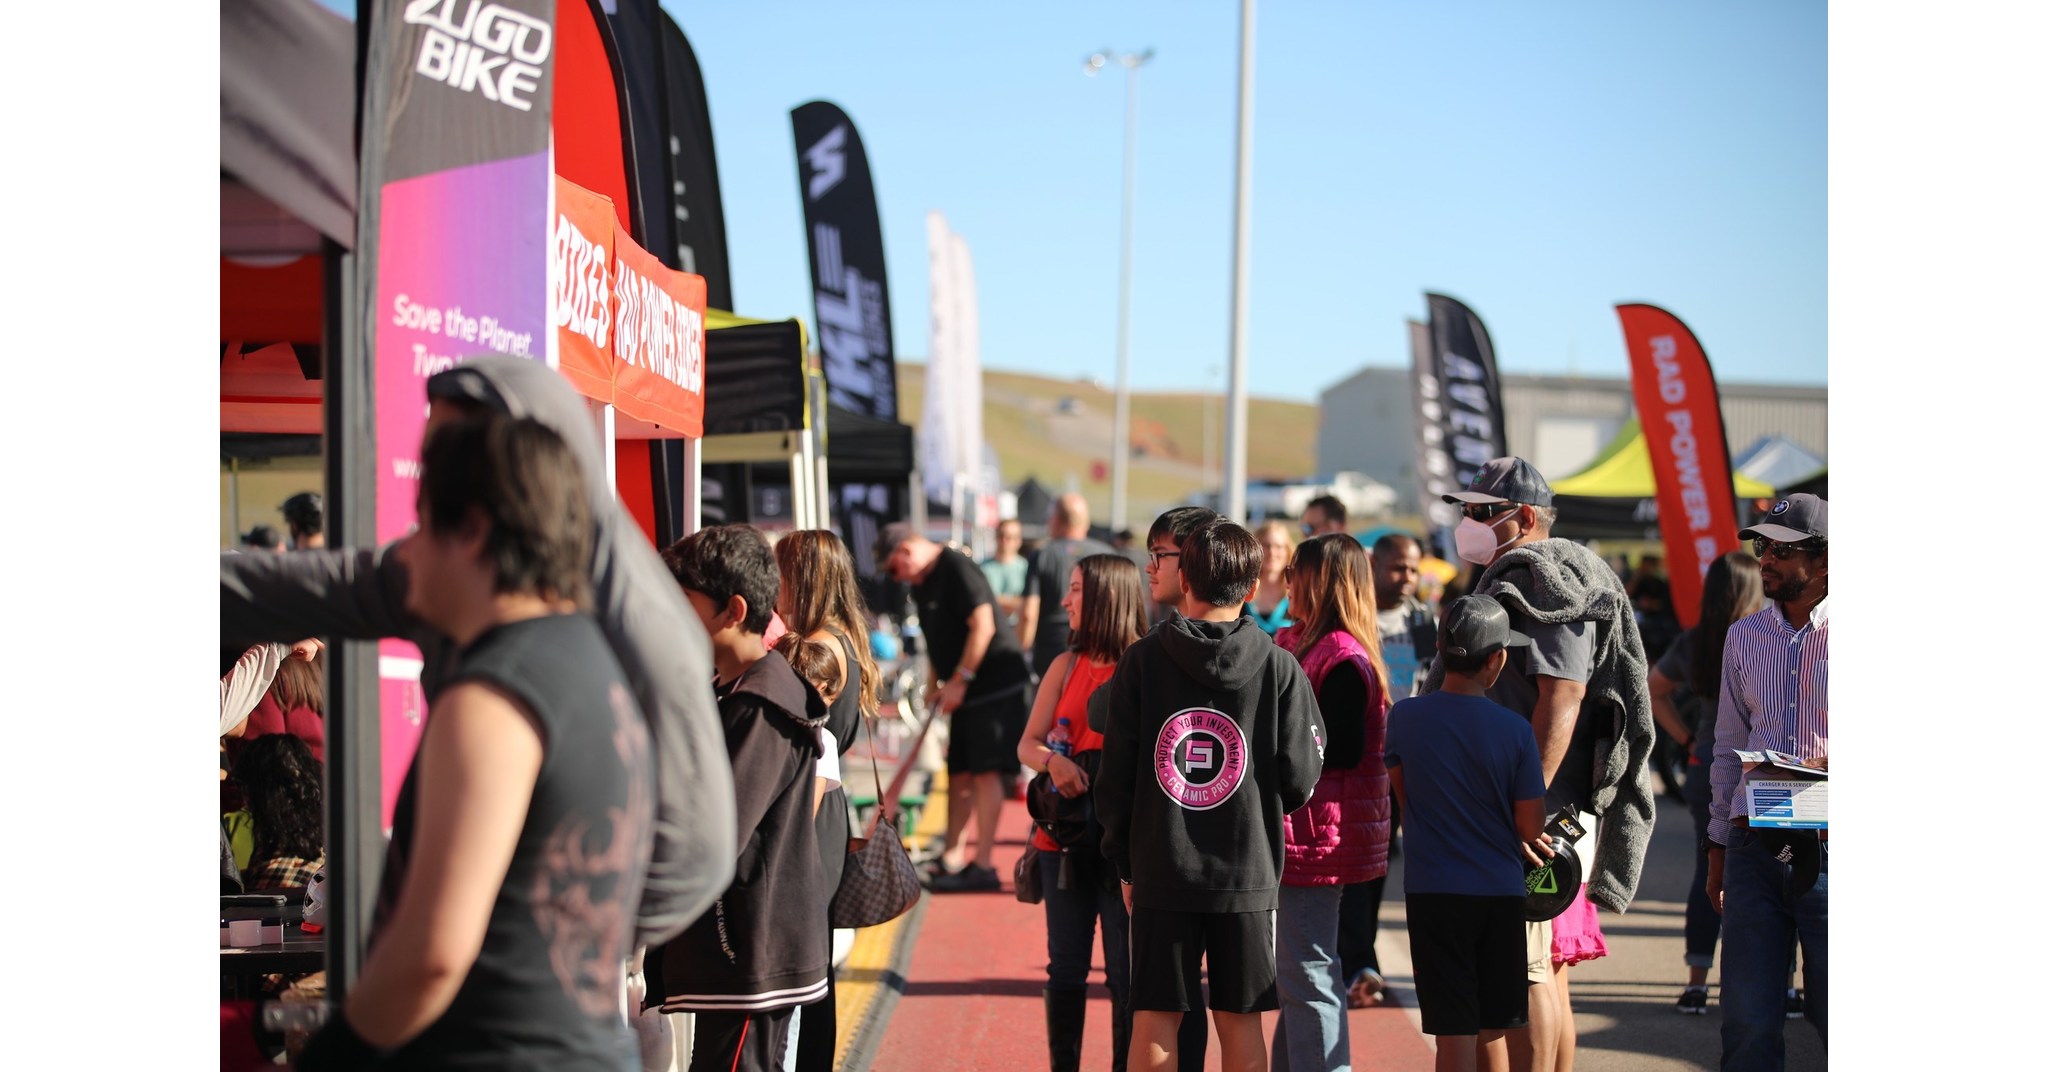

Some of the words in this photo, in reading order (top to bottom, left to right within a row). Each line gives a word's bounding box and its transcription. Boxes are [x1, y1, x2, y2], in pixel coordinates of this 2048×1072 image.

[403, 0, 552, 65] ZUGO
[416, 28, 543, 112] BIKE
[393, 294, 442, 334] Save
[444, 305, 478, 343] the
[615, 257, 640, 367] RAD
[638, 275, 677, 384] POWER
[674, 301, 703, 396] BIKES
[1649, 335, 1687, 405] RAD
[1666, 409, 1712, 531] POWER
[1158, 726, 1179, 769] PROTECT
[1177, 716, 1203, 729] YOUR
[1205, 717, 1240, 771] INVESTMENT
[1167, 776, 1209, 802] CERAMIC
[1211, 778, 1230, 797] PRO
